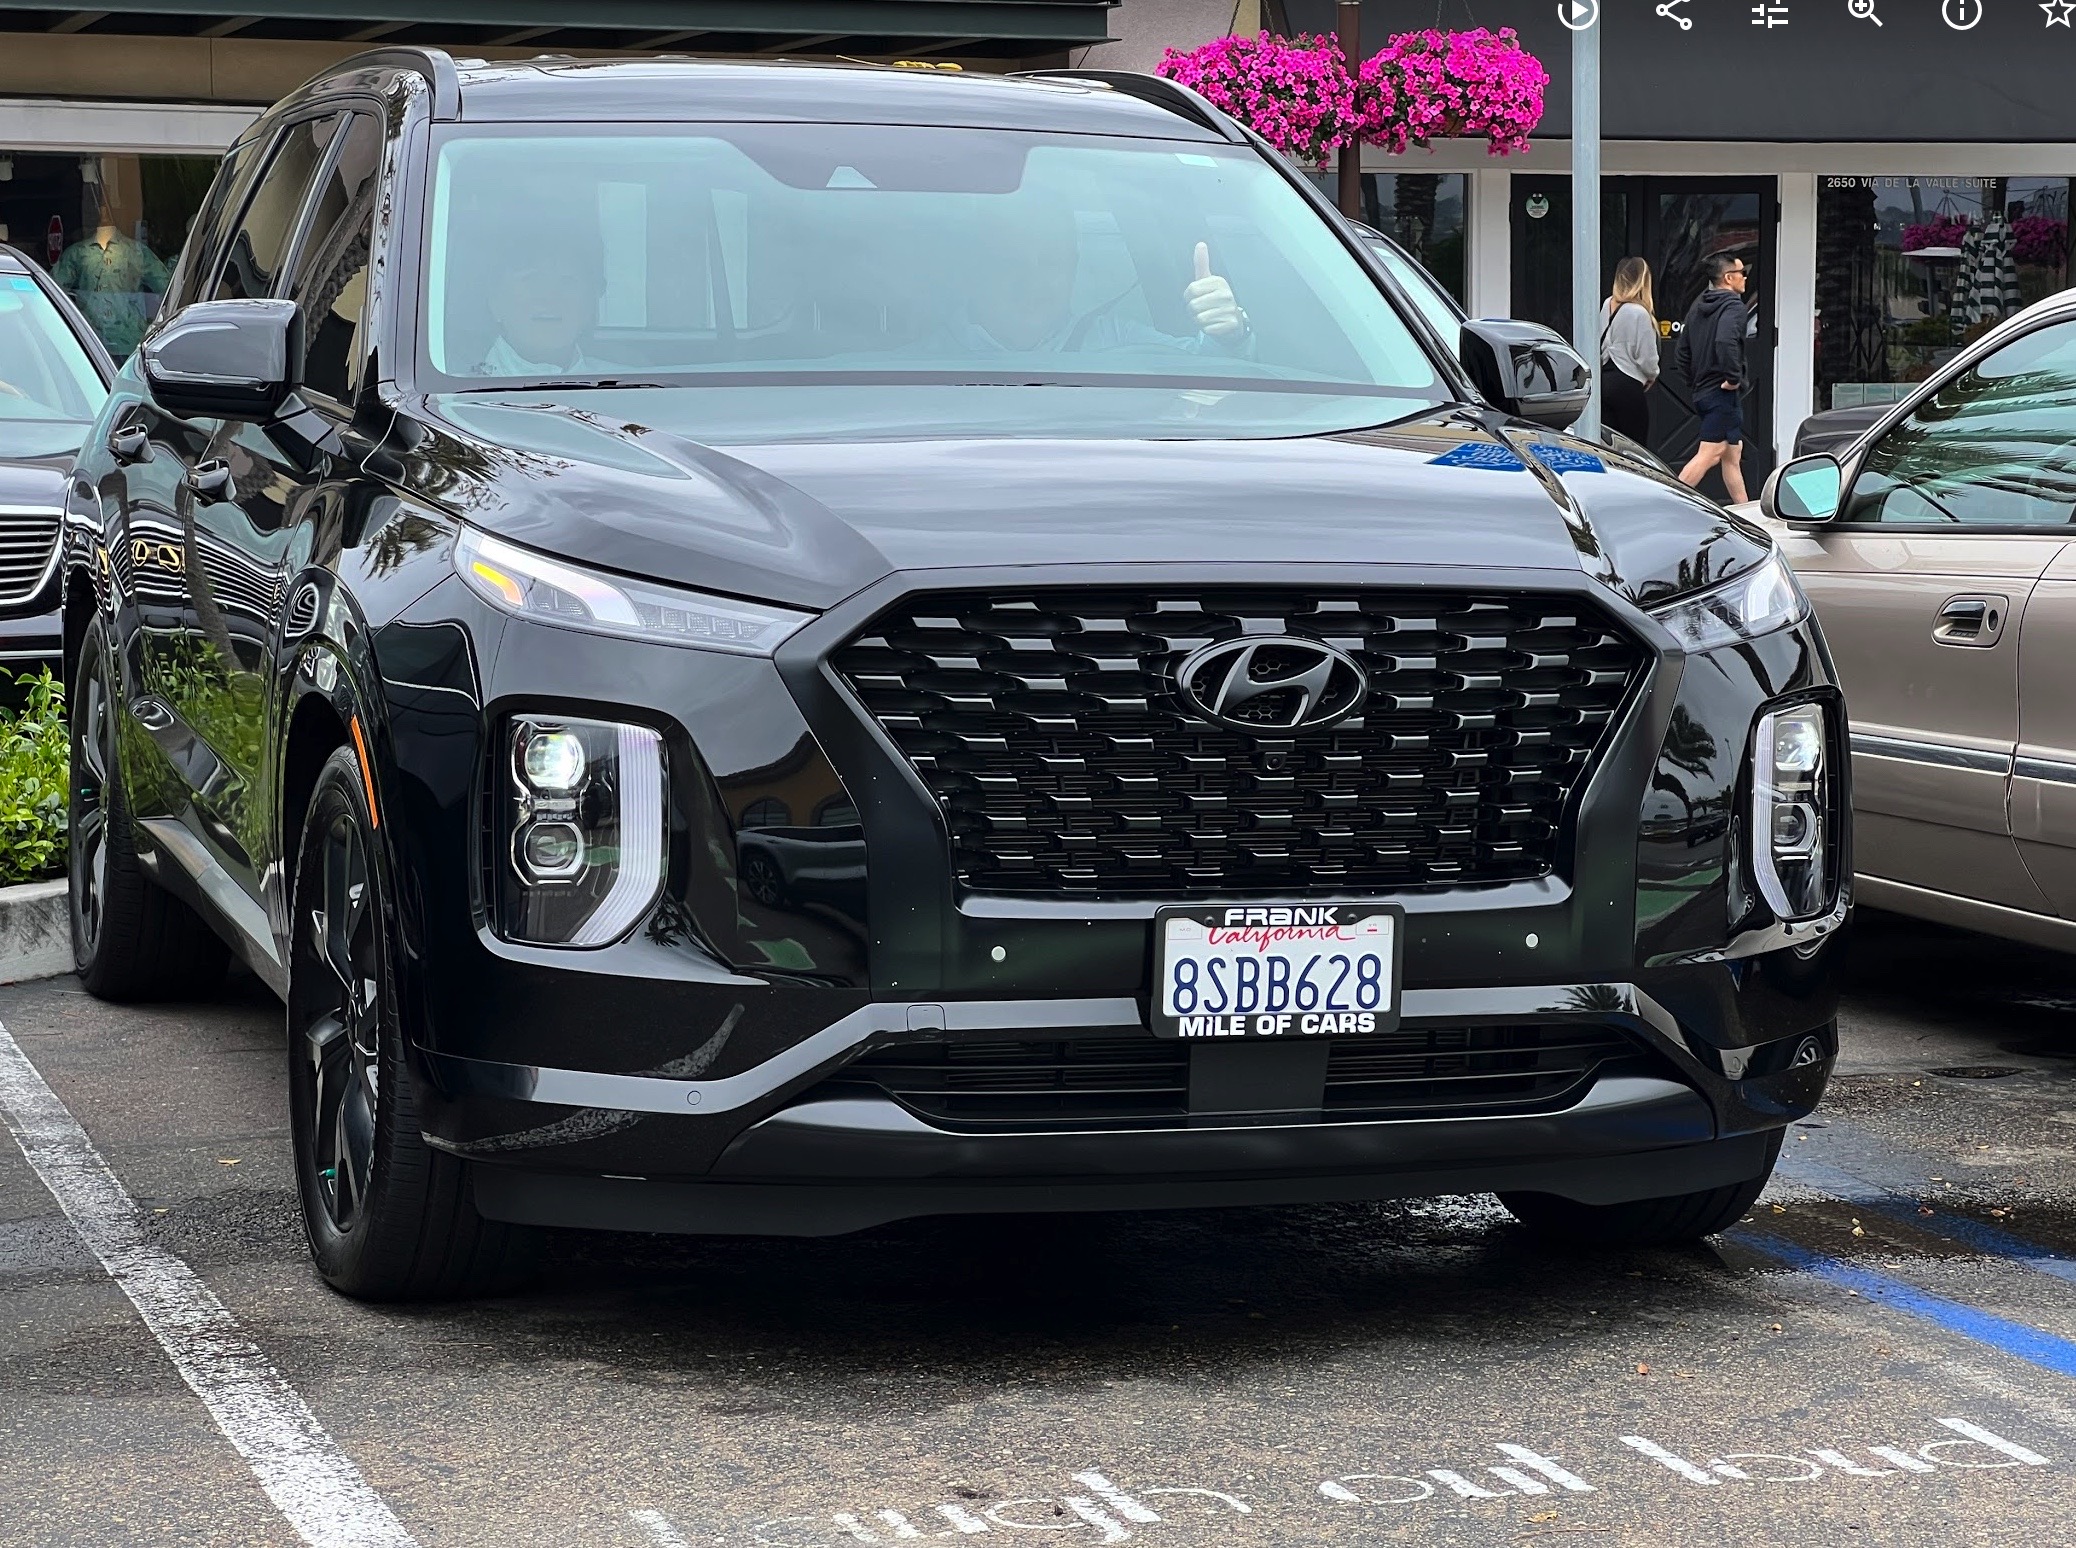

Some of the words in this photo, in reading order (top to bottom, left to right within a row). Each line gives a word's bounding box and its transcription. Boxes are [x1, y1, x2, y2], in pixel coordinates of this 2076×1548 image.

[1827, 177, 1856, 188] 2650
[1861, 177, 1879, 188] VIA
[1884, 178, 1900, 188] DE
[1905, 178, 1920, 188] LA
[1925, 178, 1959, 188] VALLE
[1964, 178, 1997, 188] SUITE
[1224, 906, 1339, 926] FRANK
[1208, 925, 1356, 953] California
[1172, 953, 1382, 1014] 8SBB628
[1178, 1016, 1246, 1037] MILE
[1255, 1014, 1292, 1036] OF
[1300, 1012, 1376, 1034] CARS
[1318, 1441, 1597, 1504] out
[1618, 1416, 2051, 1486] loud
